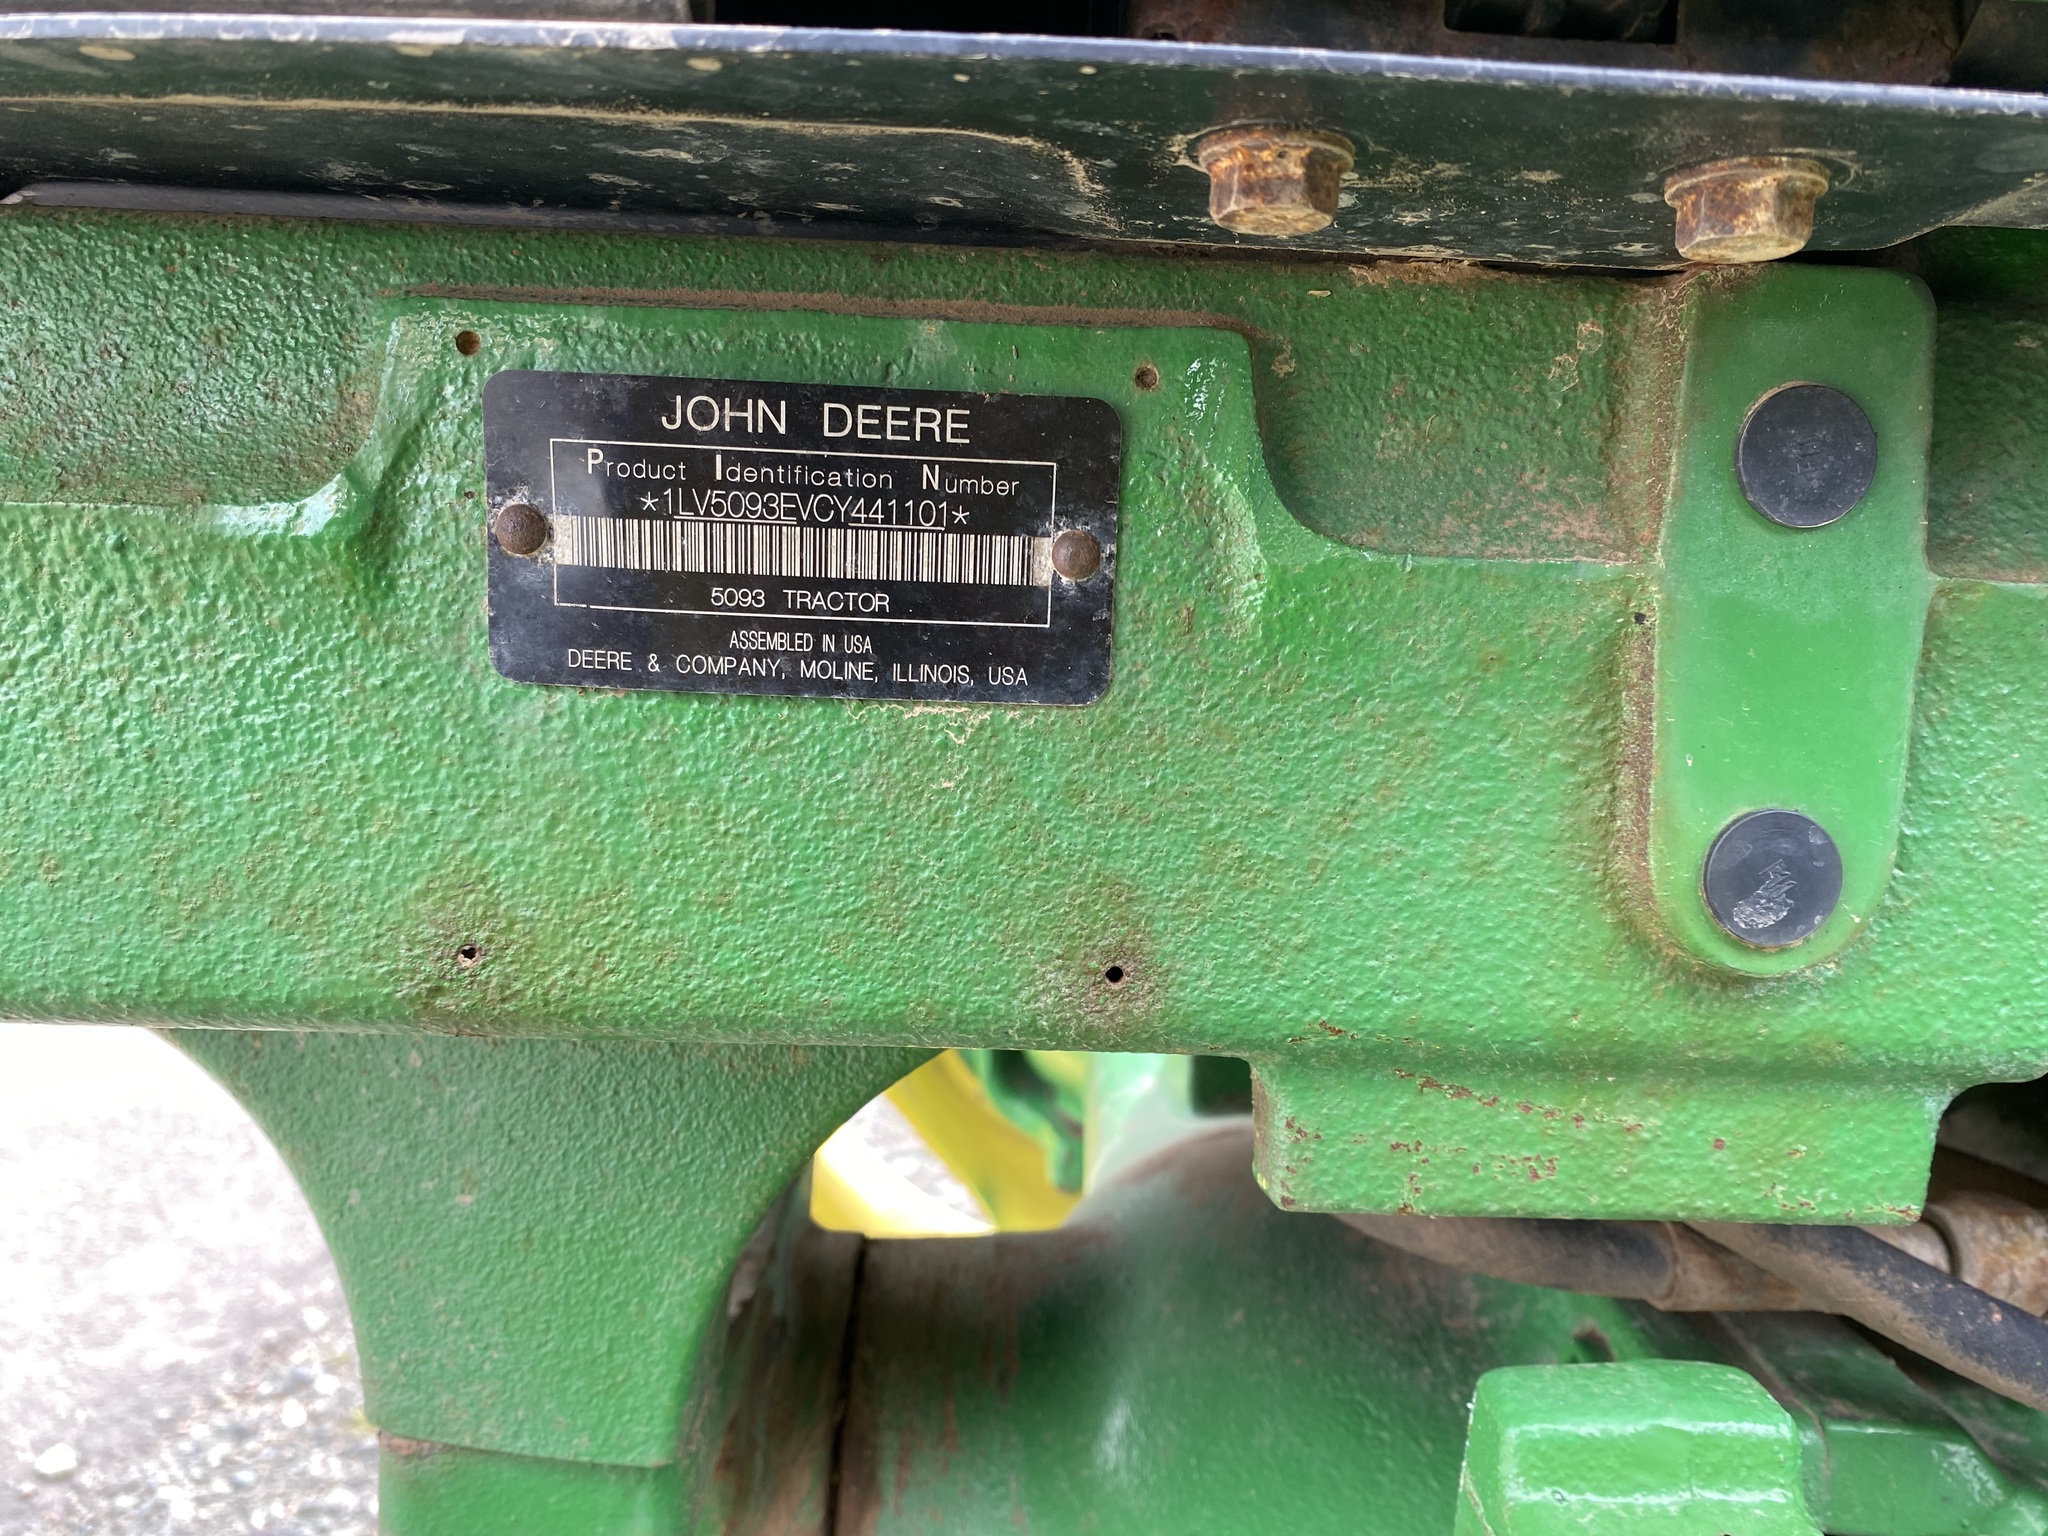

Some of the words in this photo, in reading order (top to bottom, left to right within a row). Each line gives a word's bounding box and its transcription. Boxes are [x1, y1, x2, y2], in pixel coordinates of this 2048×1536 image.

[661, 395, 786, 435] JOHN
[823, 402, 971, 444] DEERE
[587, 448, 686, 481] Product
[715, 454, 893, 489] Identification
[922, 464, 1020, 496] Number
[711, 587, 766, 608] 5093
[782, 589, 890, 612] TRACTOR
[729, 630, 813, 652] ASSEMBLED
[822, 634, 835, 652] IN
[844, 635, 873, 654] USA
[568, 649, 632, 671] DEERE
[647, 654, 660, 672] &
[676, 655, 786, 679] COMPANY,
[800, 660, 878, 683] MOLINE,
[893, 663, 974, 686] ILLINOIS,
[988, 667, 1028, 686] USA
